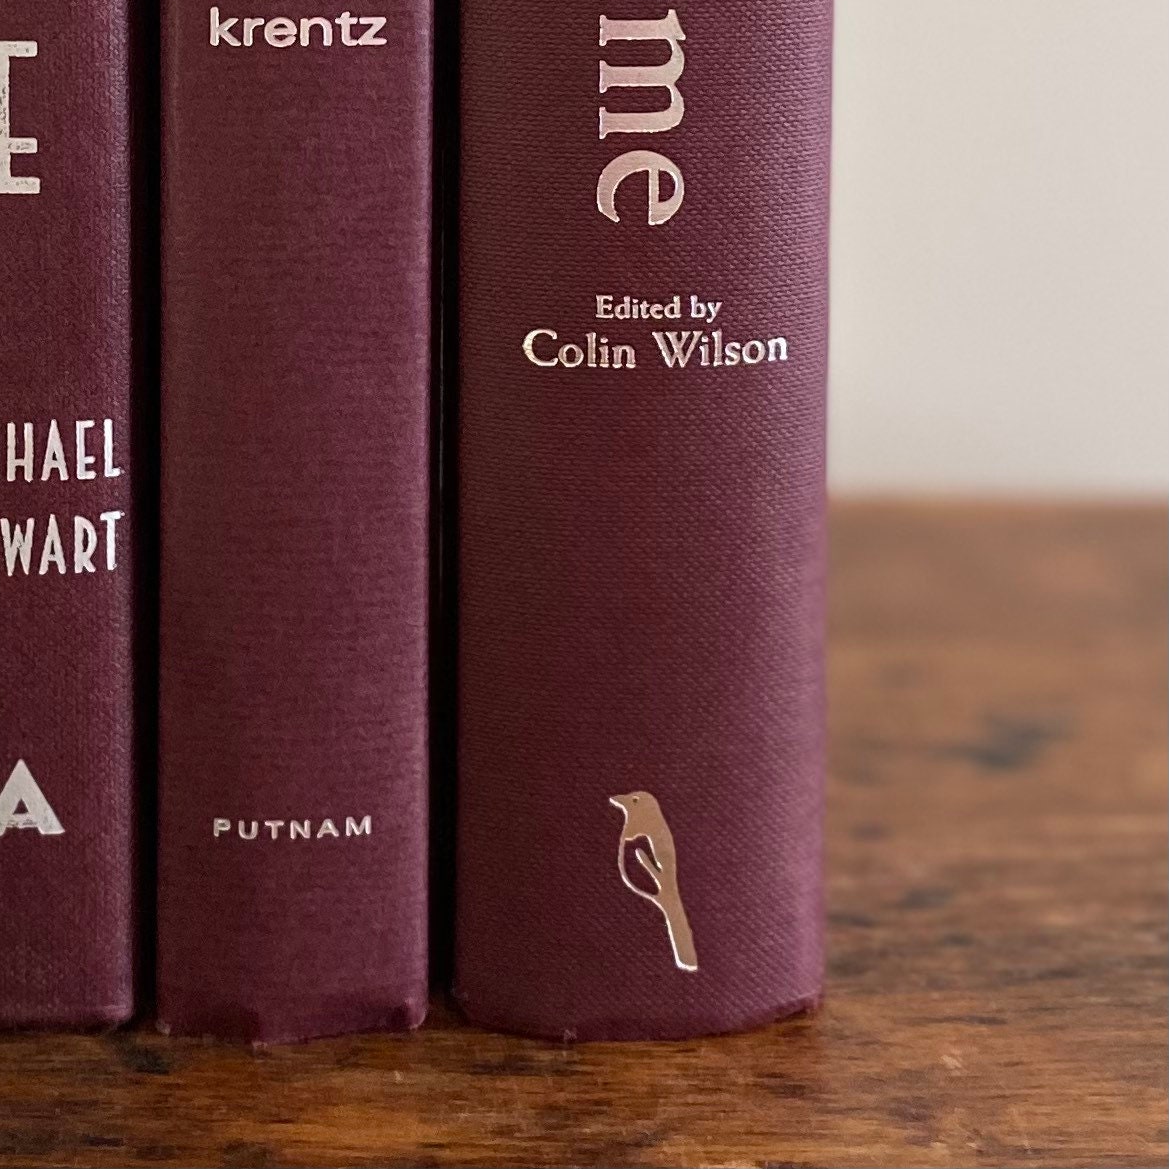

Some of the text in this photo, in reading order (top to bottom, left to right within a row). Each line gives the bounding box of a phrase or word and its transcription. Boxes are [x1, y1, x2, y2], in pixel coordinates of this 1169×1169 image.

[209, 6, 388, 48] krentz
[595, 294, 722, 323] Edited by
[521, 329, 789, 369] Colin Wilson
[213, 815, 372, 840] PUTNAM
